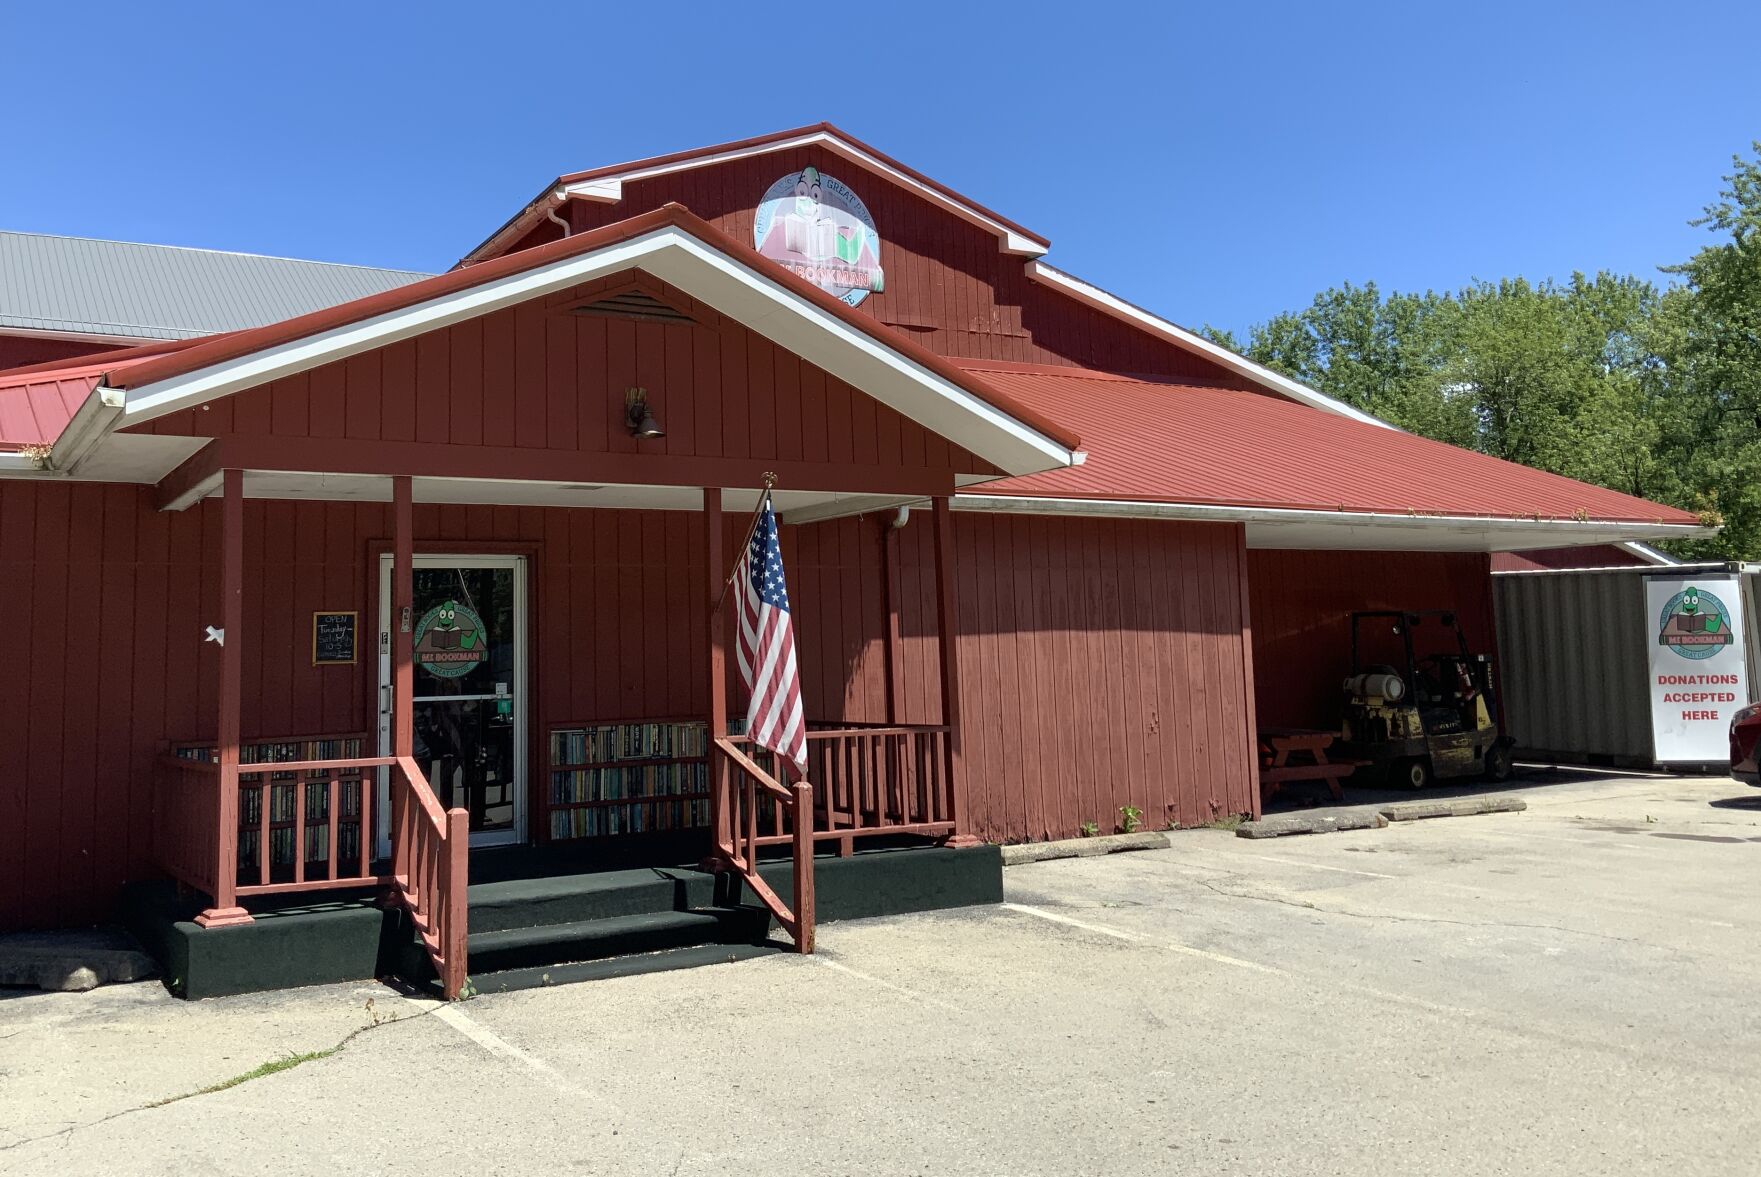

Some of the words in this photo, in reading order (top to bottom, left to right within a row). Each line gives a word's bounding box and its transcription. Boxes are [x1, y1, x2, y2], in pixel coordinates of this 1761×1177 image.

[826, 179, 856, 204] GREAT
[795, 265, 870, 287] BOOKMAN
[457, 606, 475, 619] GREAT
[325, 616, 348, 624] OPEN
[1682, 636, 1725, 644] BOOKMAN
[435, 652, 480, 662] BOOKMAN
[430, 665, 449, 676] GREAT
[450, 665, 471, 676] CAUSE
[1658, 674, 1739, 686] DONATIONS
[1663, 692, 1736, 703] ACCEPTED
[1682, 710, 1719, 721] HERE
